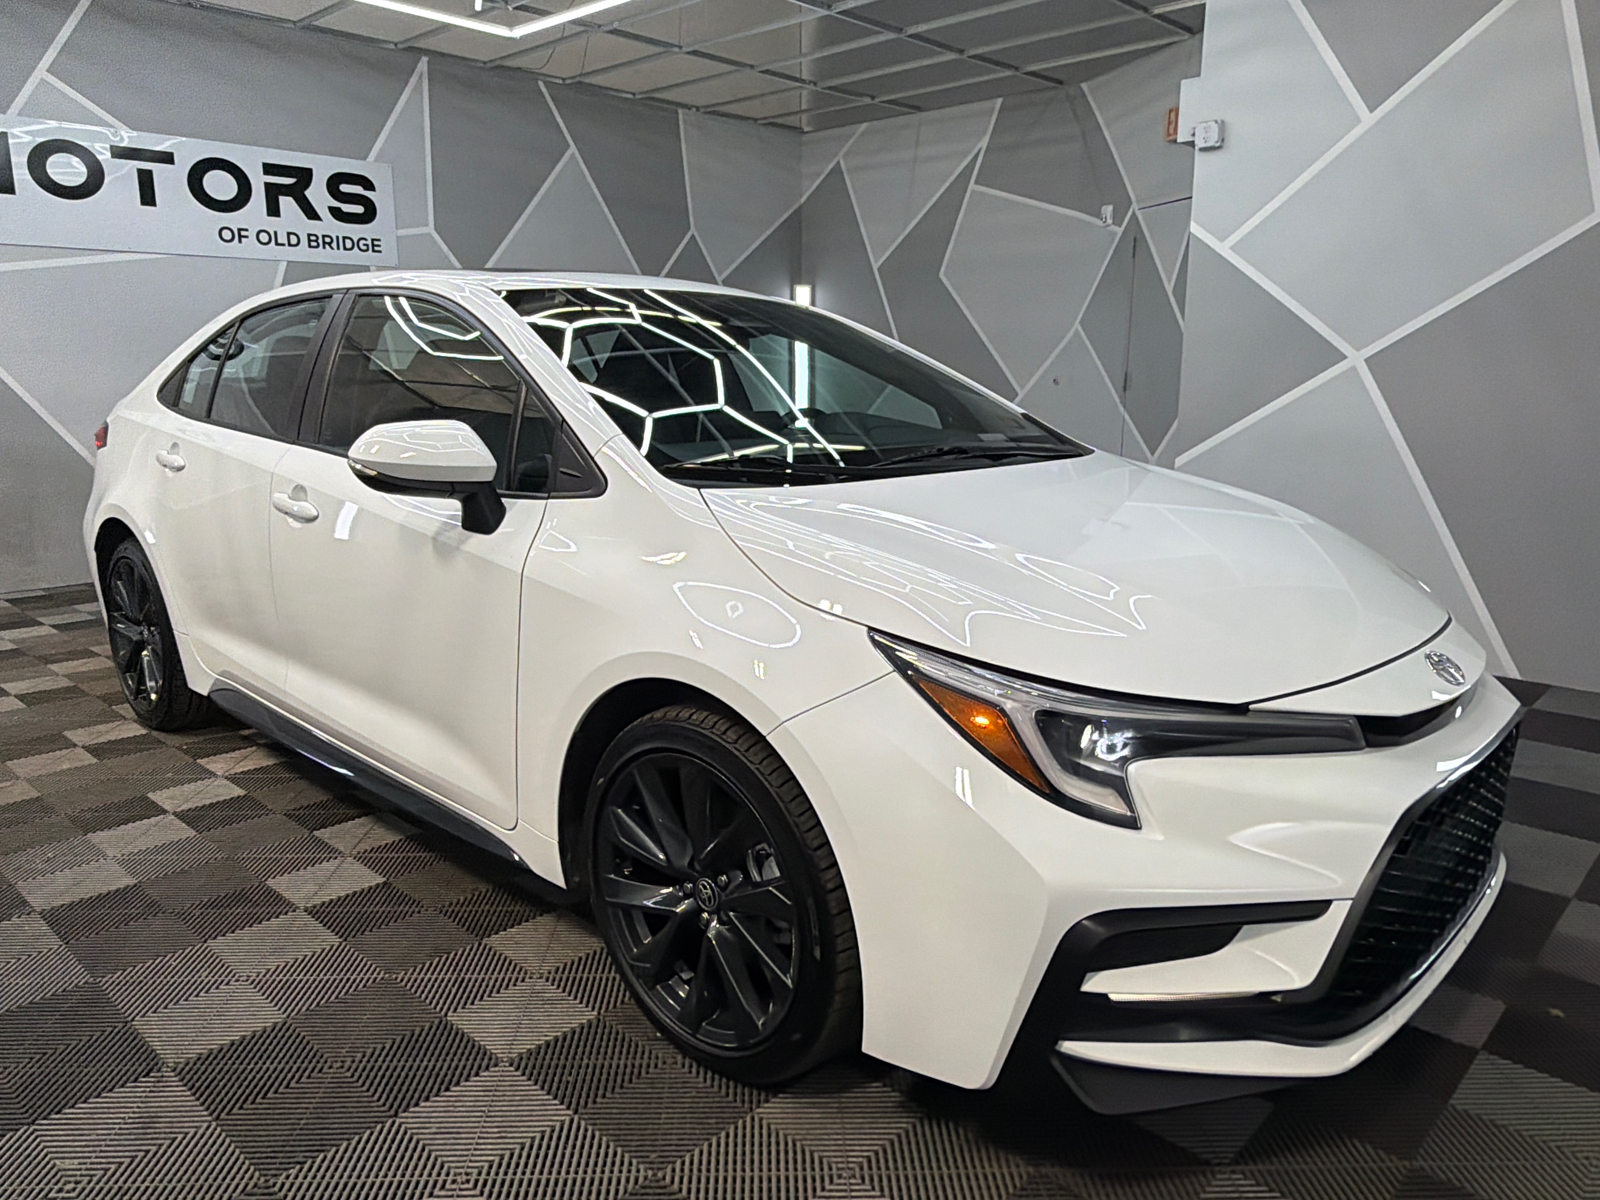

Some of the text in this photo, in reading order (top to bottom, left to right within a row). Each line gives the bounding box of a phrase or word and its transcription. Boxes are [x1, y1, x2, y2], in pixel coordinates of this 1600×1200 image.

[0, 131, 378, 226] OTORS
[218, 226, 383, 254] OF OLD BRIDGE
